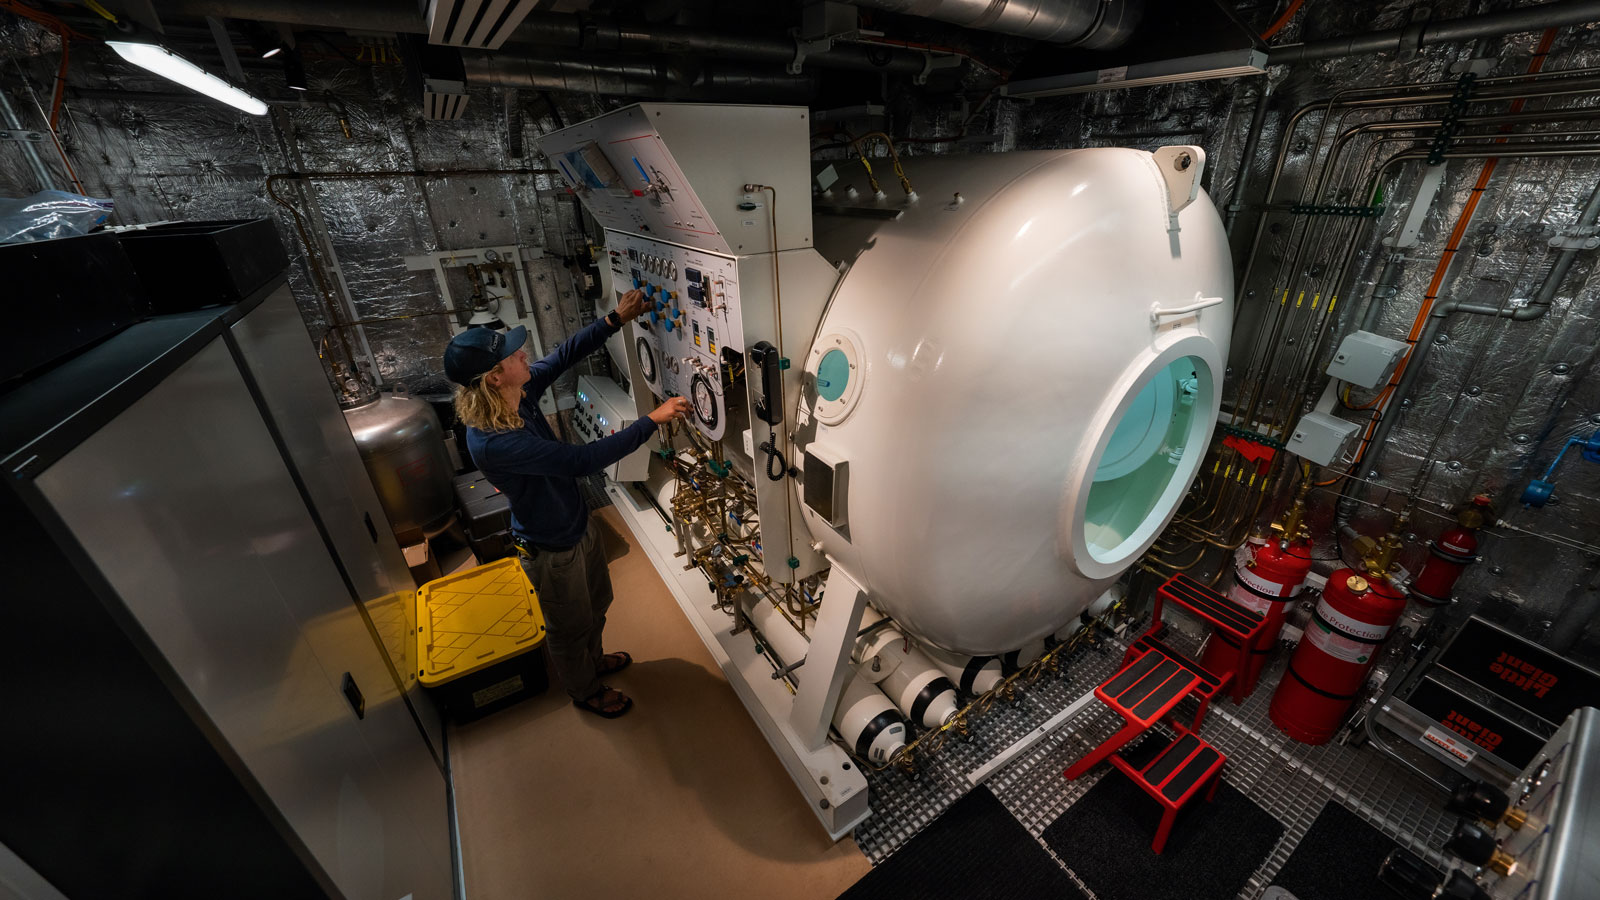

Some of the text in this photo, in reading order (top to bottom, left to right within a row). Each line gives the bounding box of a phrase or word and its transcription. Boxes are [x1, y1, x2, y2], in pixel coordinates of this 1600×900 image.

[1329, 616, 1382, 639] Protection
[1489, 661, 1550, 699] Little
[1496, 651, 1559, 688] Giant
[1446, 709, 1503, 747] Giant
